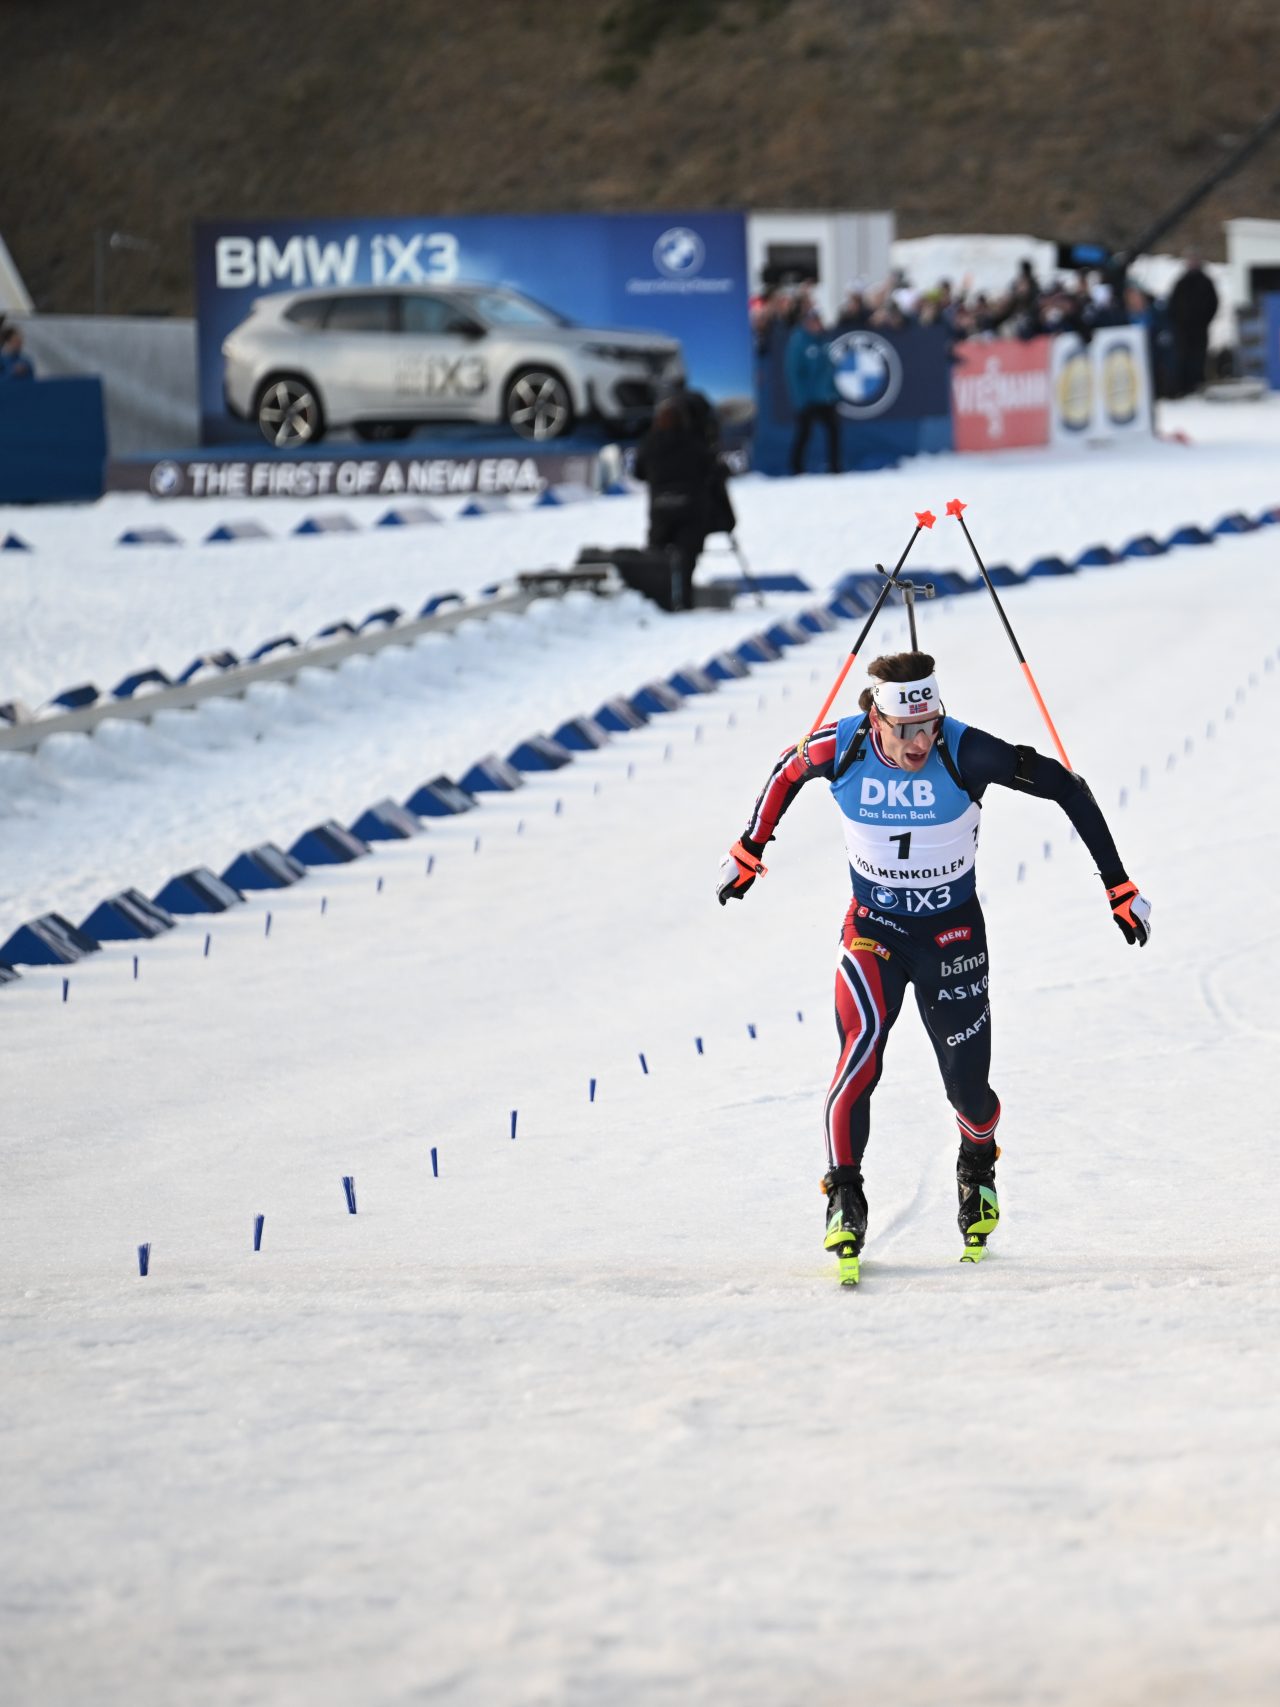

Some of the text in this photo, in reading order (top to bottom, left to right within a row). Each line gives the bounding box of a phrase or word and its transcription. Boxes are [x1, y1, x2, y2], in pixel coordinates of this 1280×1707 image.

[216, 233, 459, 288] BMW iX3
[187, 462, 248, 497] THE
[252, 461, 336, 496] FIRST
[336, 461, 379, 495] OF
[379, 461, 406, 494] A
[407, 460, 478, 494] NEW
[899, 684, 933, 704] ice
[860, 777, 935, 807] DKB
[859, 808, 936, 820] Das kann Bank
[889, 832, 911, 859] 1
[905, 886, 952, 912] iX3
[939, 930, 968, 944] MENY
[946, 1011, 987, 1047] CRAFT
